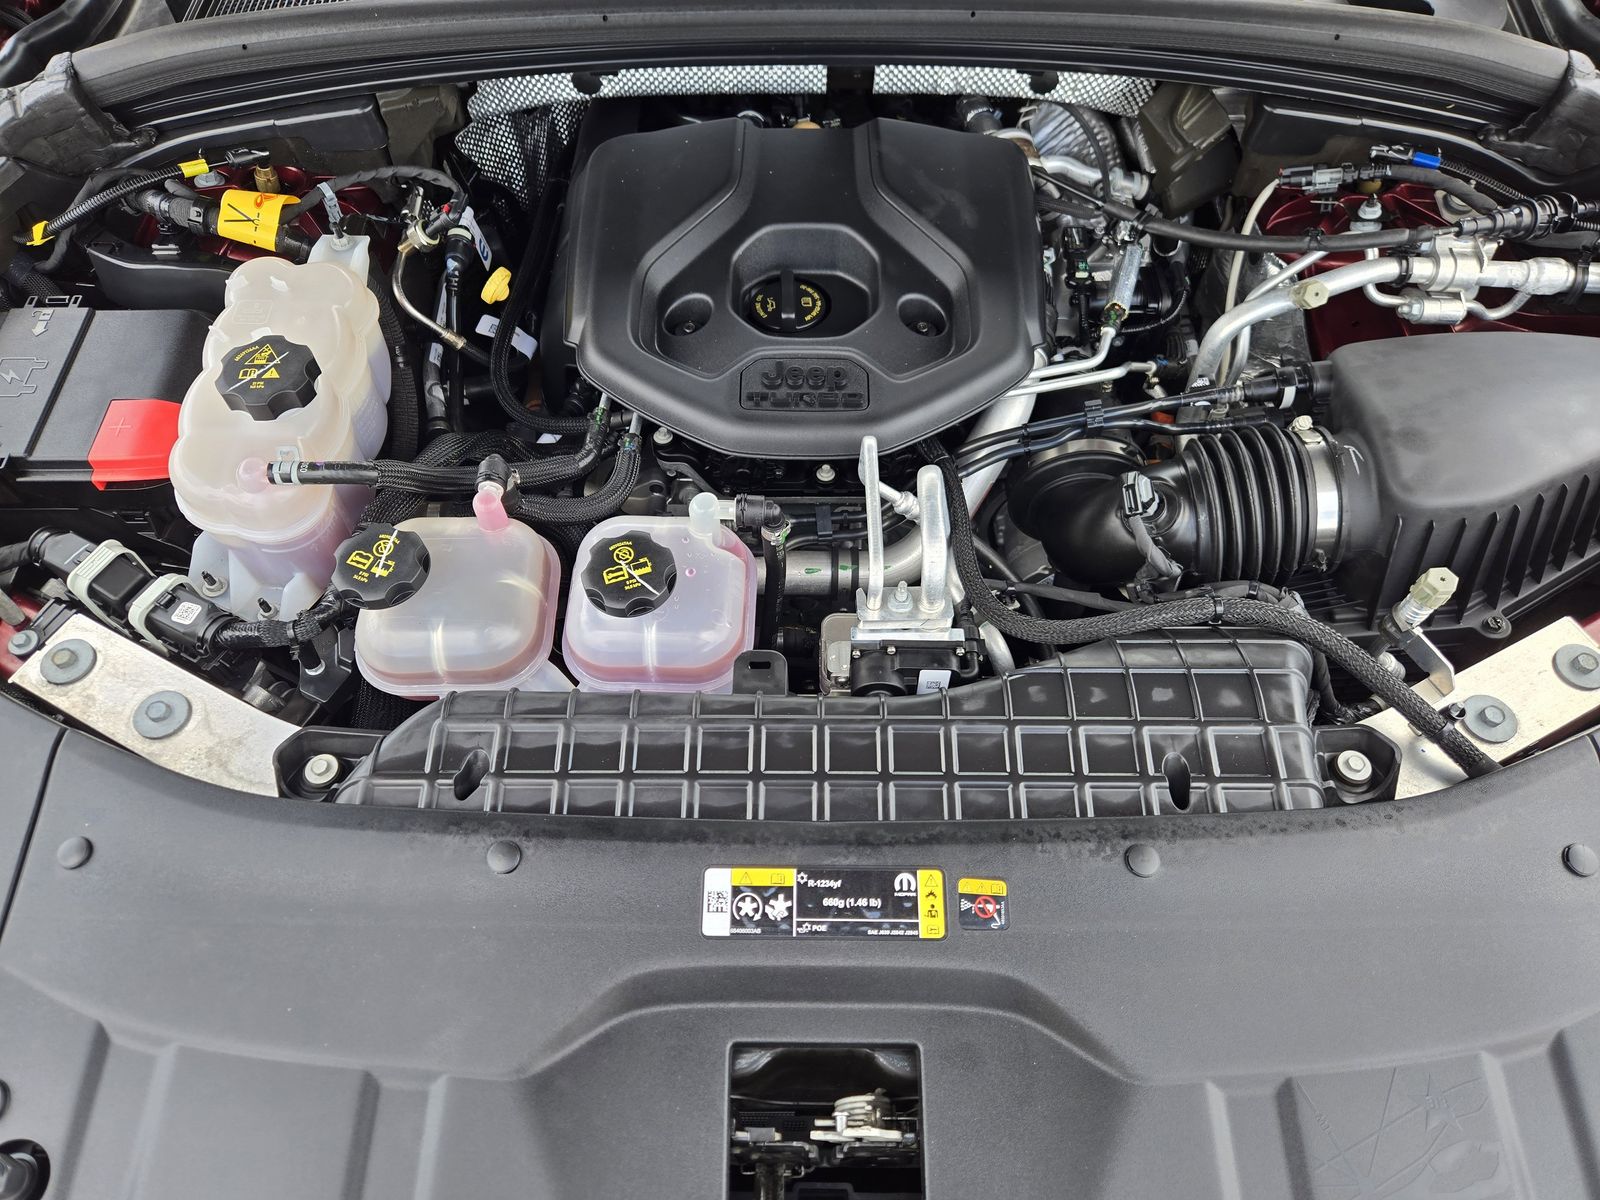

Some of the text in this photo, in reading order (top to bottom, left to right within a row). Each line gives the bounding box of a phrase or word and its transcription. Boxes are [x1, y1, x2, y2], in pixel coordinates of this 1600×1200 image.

[760, 360, 849, 391] Jeep
[745, 391, 865, 408] TURBO
[807, 879, 842, 890] R-1234yf
[822, 897, 882, 909] 660g (1.46 lb)
[812, 924, 828, 932] POE
